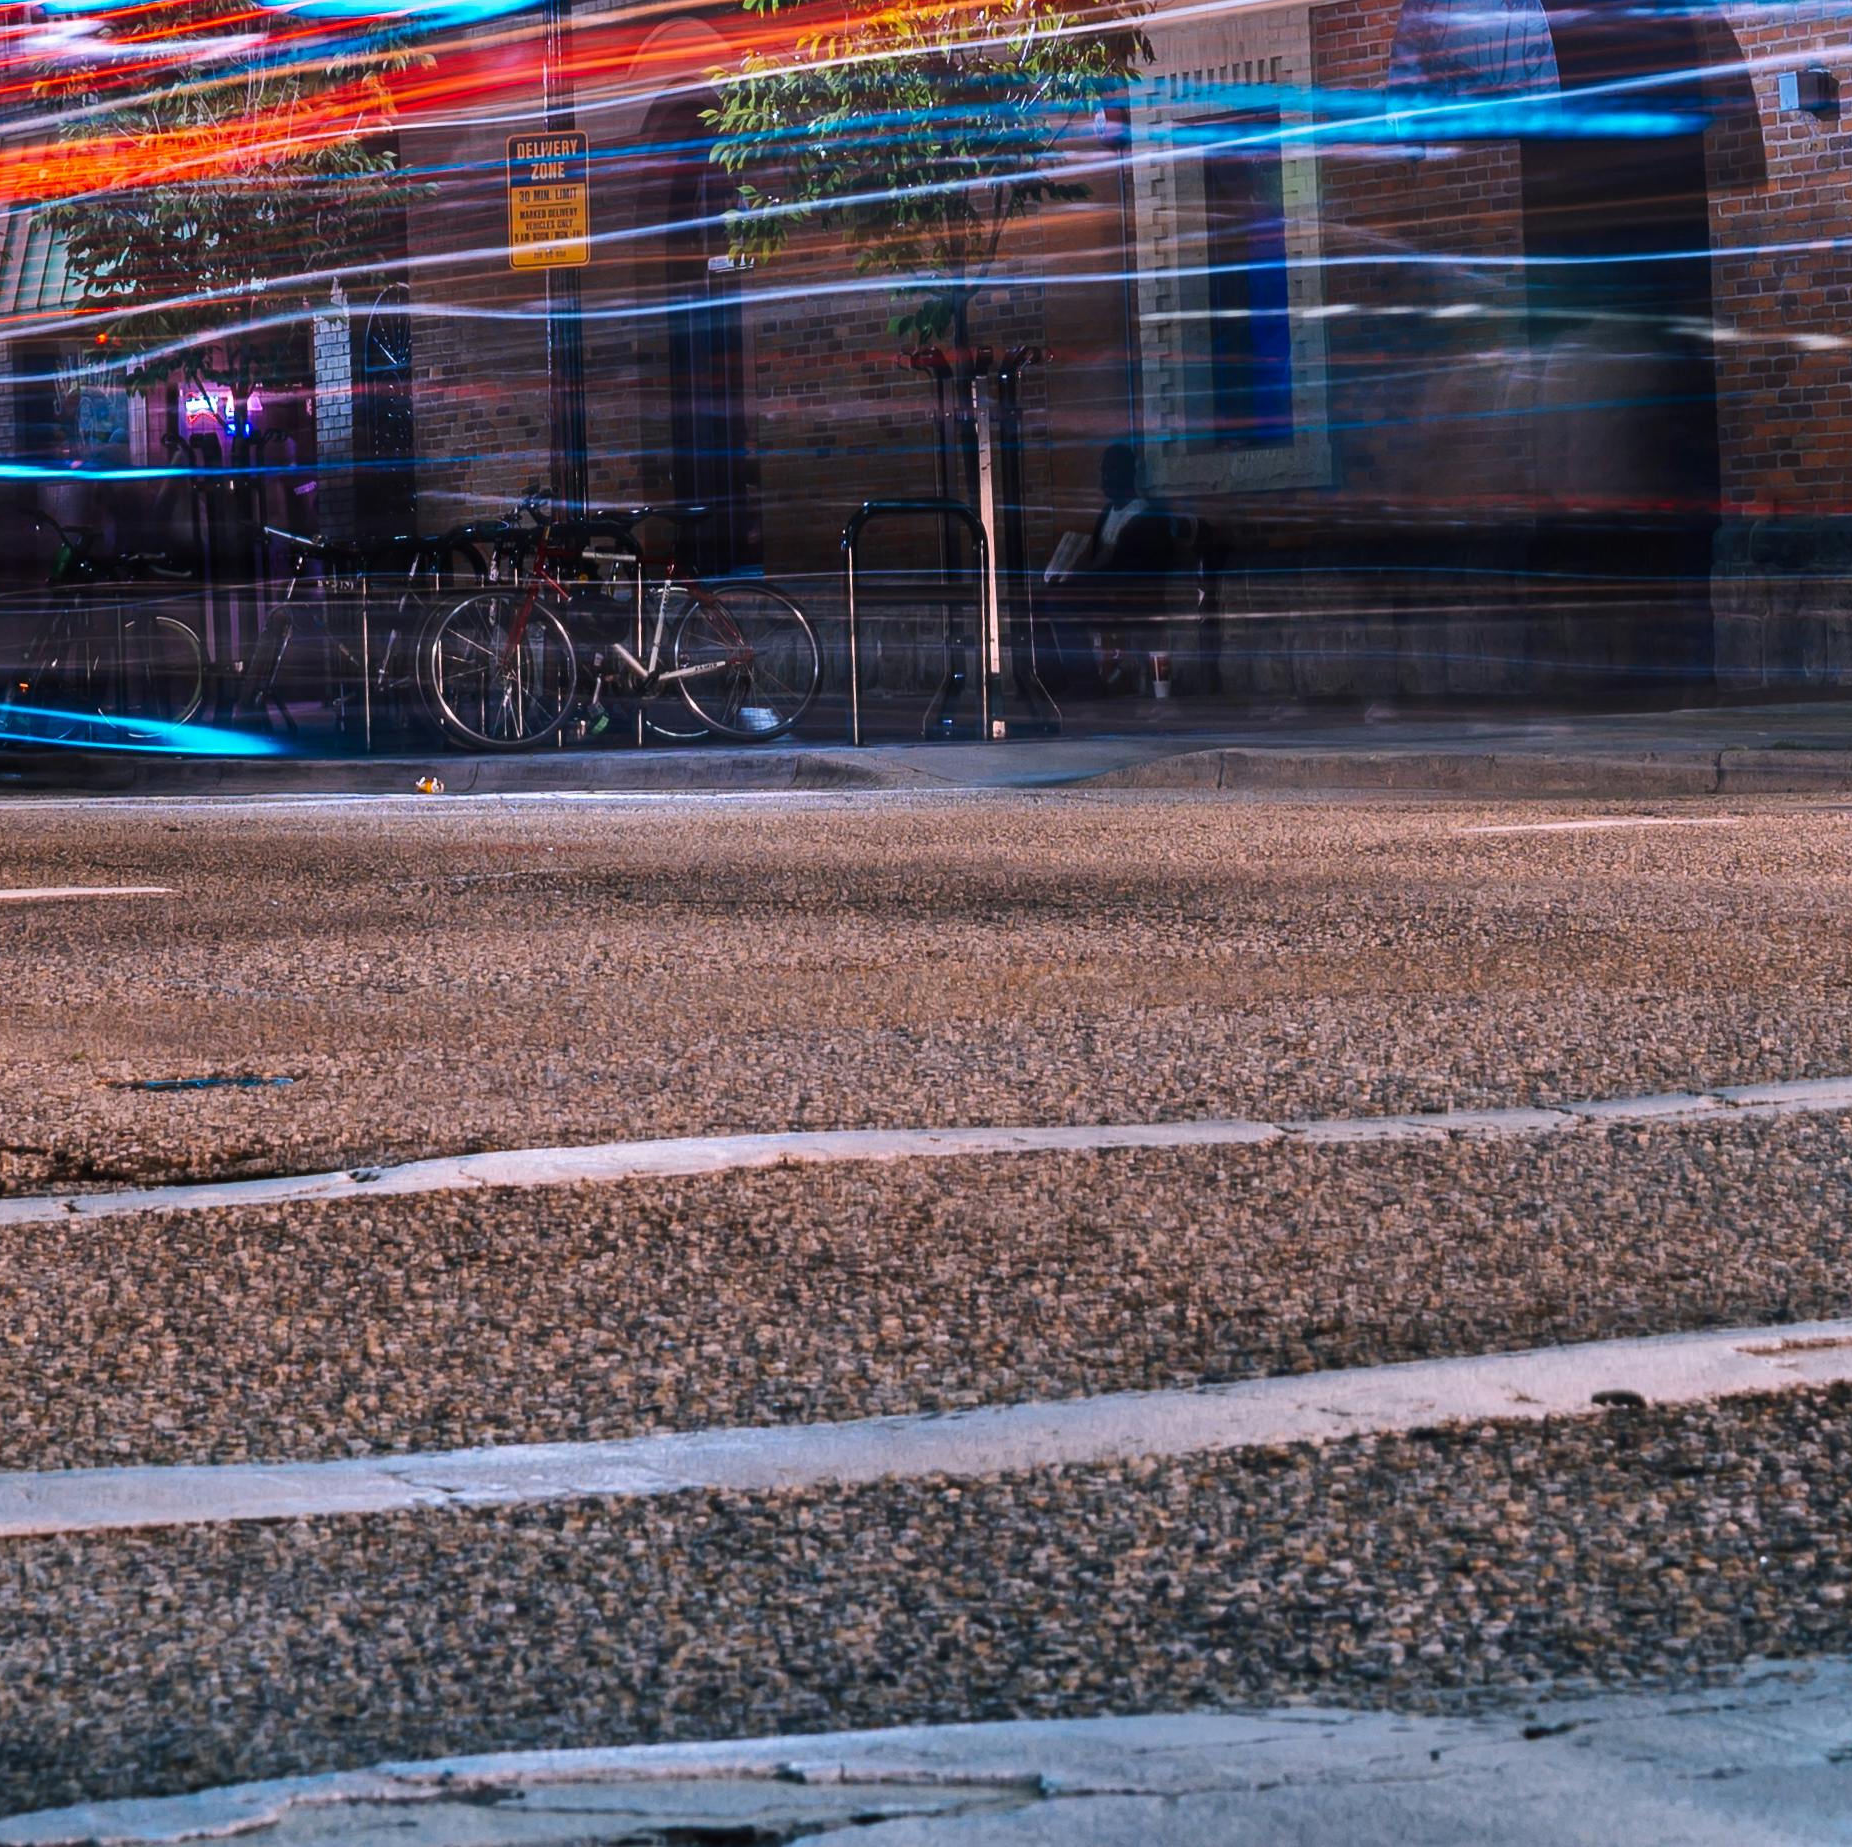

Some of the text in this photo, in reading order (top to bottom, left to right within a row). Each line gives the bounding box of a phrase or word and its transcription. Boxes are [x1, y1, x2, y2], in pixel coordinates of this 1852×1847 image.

[516, 139, 578, 160] DELIVERY
[531, 162, 566, 181] ZONE
[519, 190, 530, 203] 30
[556, 187, 578, 200] LIMIT
[520, 207, 578, 220] MARKED DELIVERY
